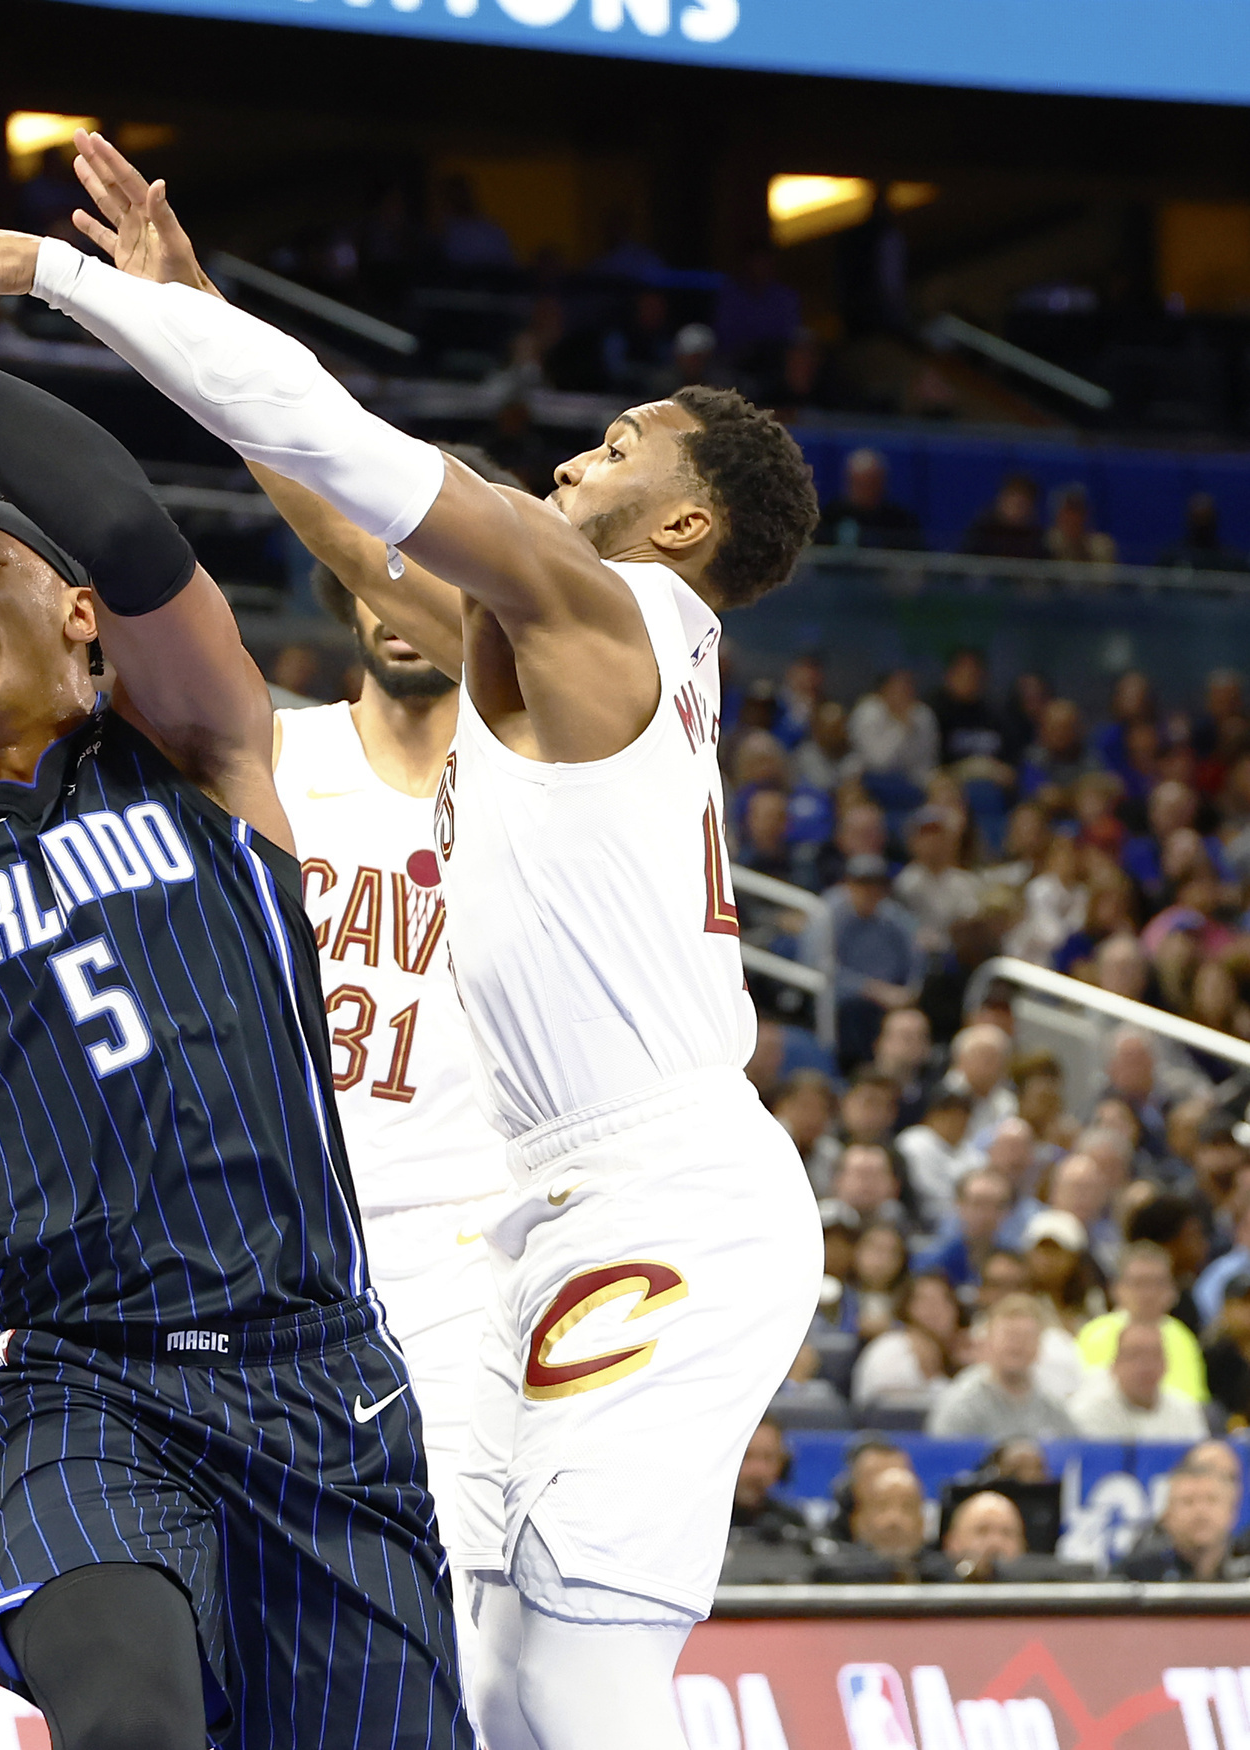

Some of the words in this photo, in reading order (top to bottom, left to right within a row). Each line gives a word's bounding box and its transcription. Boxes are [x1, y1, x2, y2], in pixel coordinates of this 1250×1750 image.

[46, 932, 153, 1080] 5
[326, 983, 420, 1104] 31
[166, 1329, 229, 1354] MAGIC
